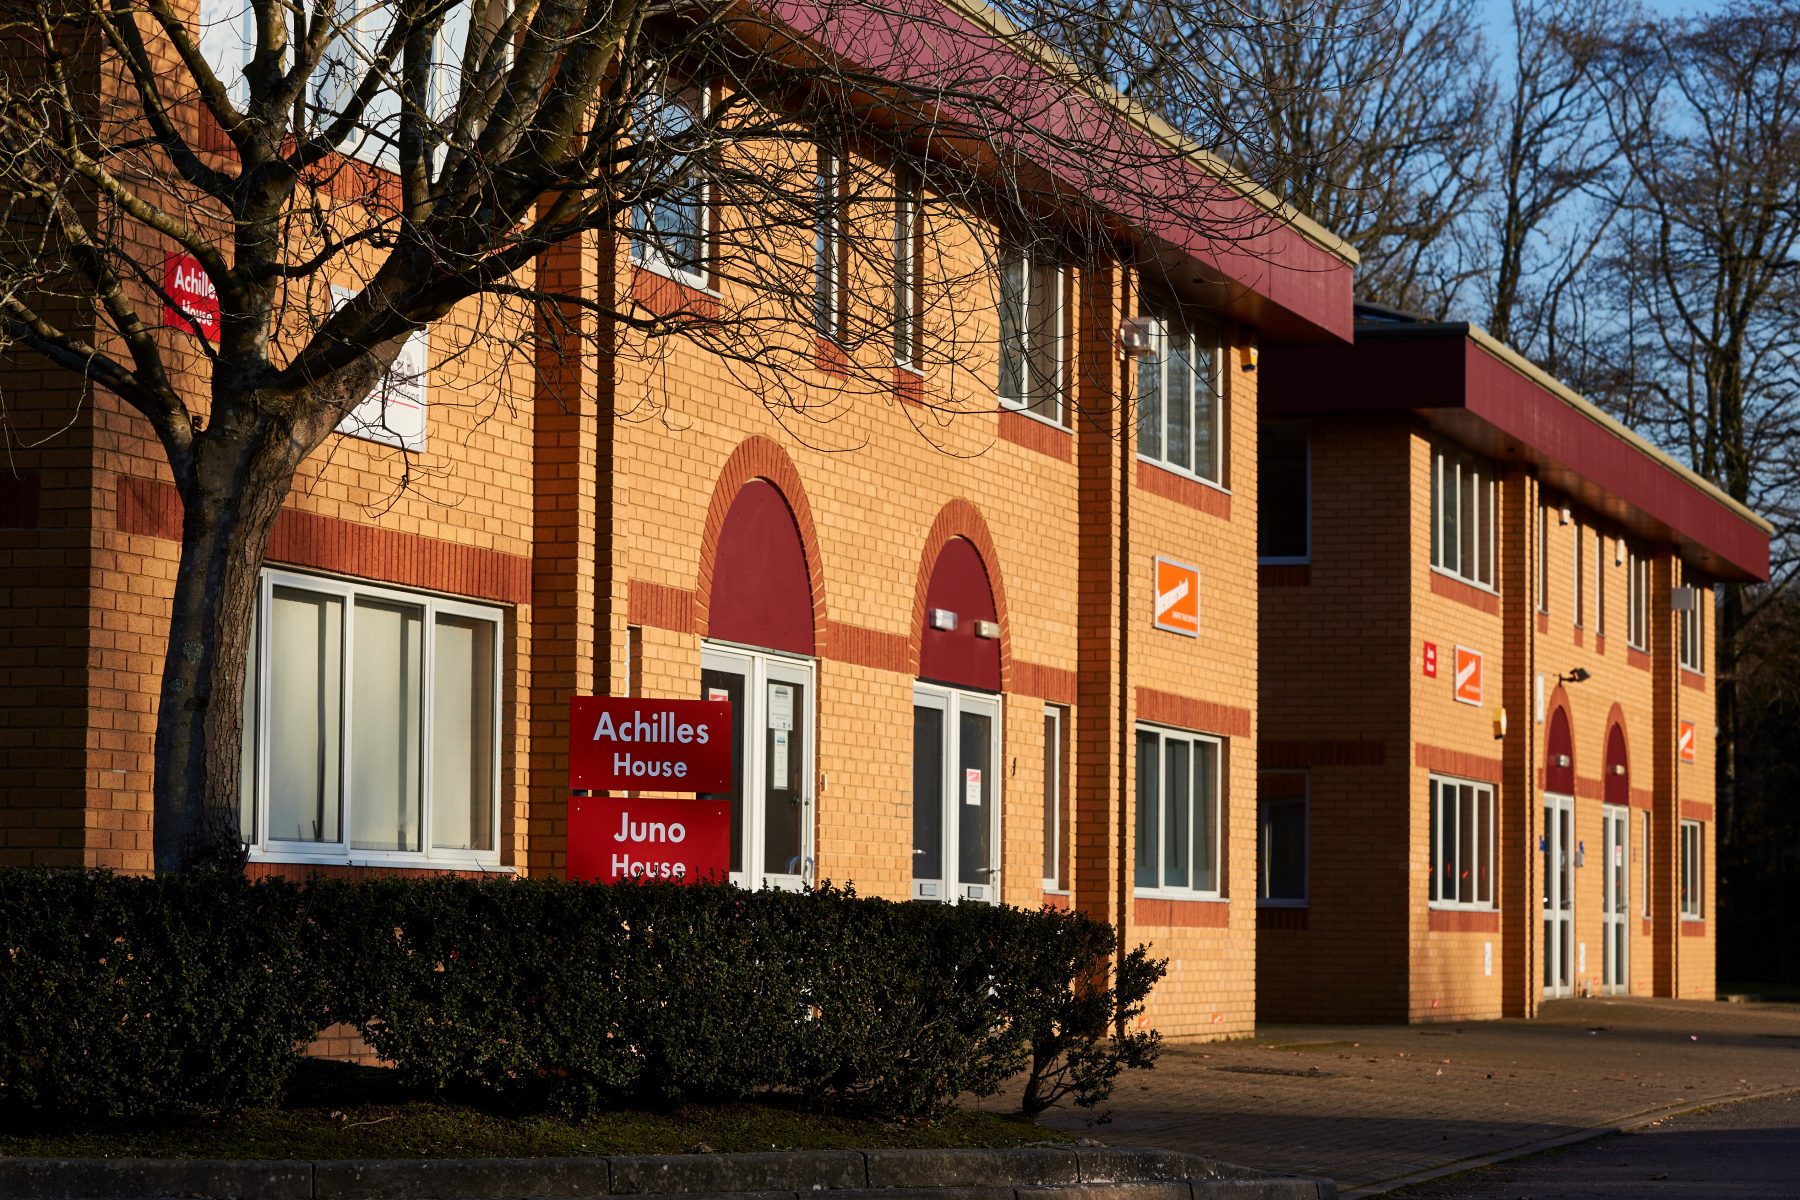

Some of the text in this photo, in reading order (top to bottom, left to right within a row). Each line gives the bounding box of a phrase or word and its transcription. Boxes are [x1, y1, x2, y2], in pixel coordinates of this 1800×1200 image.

[174, 265, 219, 301] Achille
[593, 711, 709, 744] Achilles
[613, 753, 687, 777] House
[614, 812, 686, 843] Juno
[611, 854, 686, 878] House
